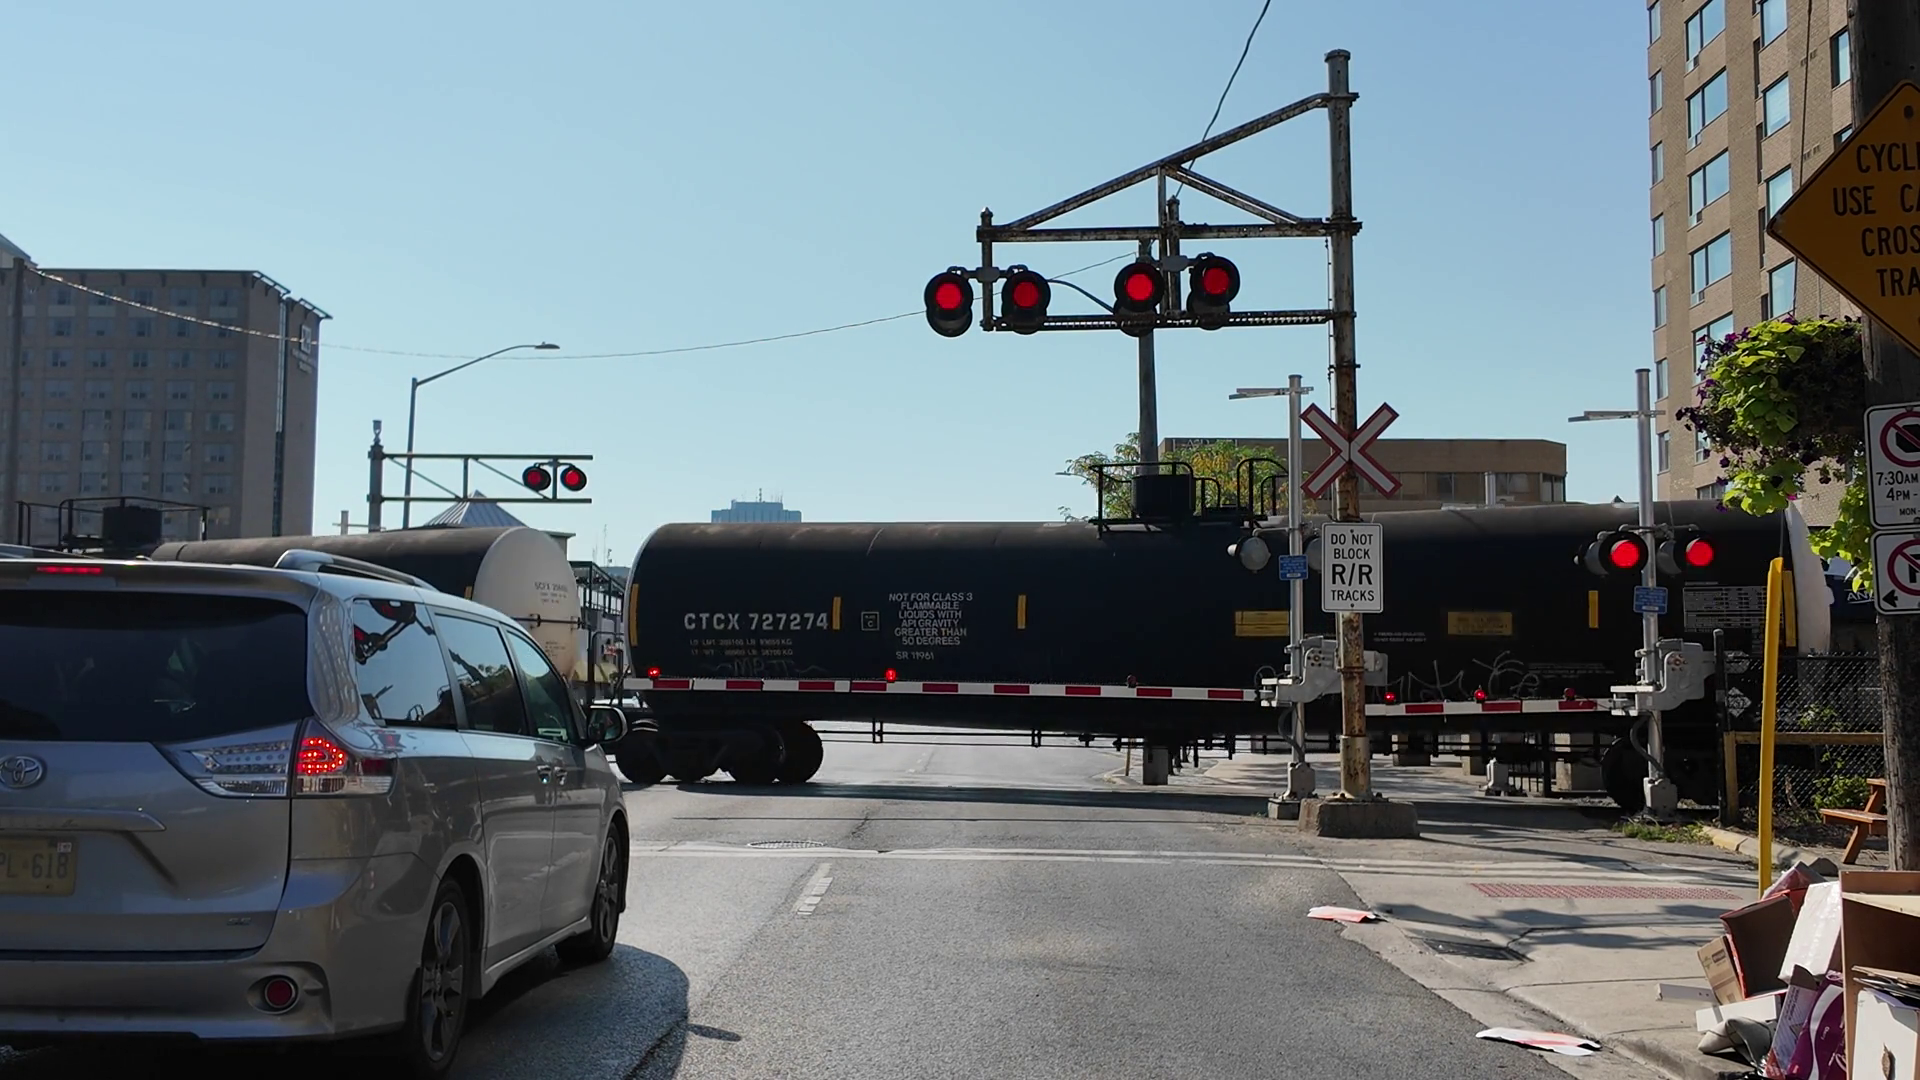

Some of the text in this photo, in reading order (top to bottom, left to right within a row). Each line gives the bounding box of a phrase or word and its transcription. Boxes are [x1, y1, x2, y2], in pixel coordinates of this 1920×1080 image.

[1833, 183, 1920, 216] USE C
[1861, 225, 1920, 257] CROS
[1876, 266, 1920, 297] TRA
[1876, 470, 1919, 486] 7:30AM
[1886, 487, 1910, 501] 4PM
[1899, 508, 1917, 516] MON
[1330, 534, 1374, 545] DO NOT
[1333, 548, 1371, 560] BLOCK
[1332, 563, 1373, 587] R/R
[888, 592, 973, 602] NOT FOR CLASS 3
[1331, 590, 1375, 602] TRACKS
[900, 601, 960, 610] FLAMMABLE
[898, 610, 962, 619] LIQUIDS WITH
[684, 612, 828, 631] CTCX 727274
[901, 619, 960, 628] API GRAVITY
[894, 628, 967, 637] GREATER THAN
[902, 637, 961, 645] 50 DEGREES
[895, 651, 909, 660] SR
[31, 852, 69, 879] 618
